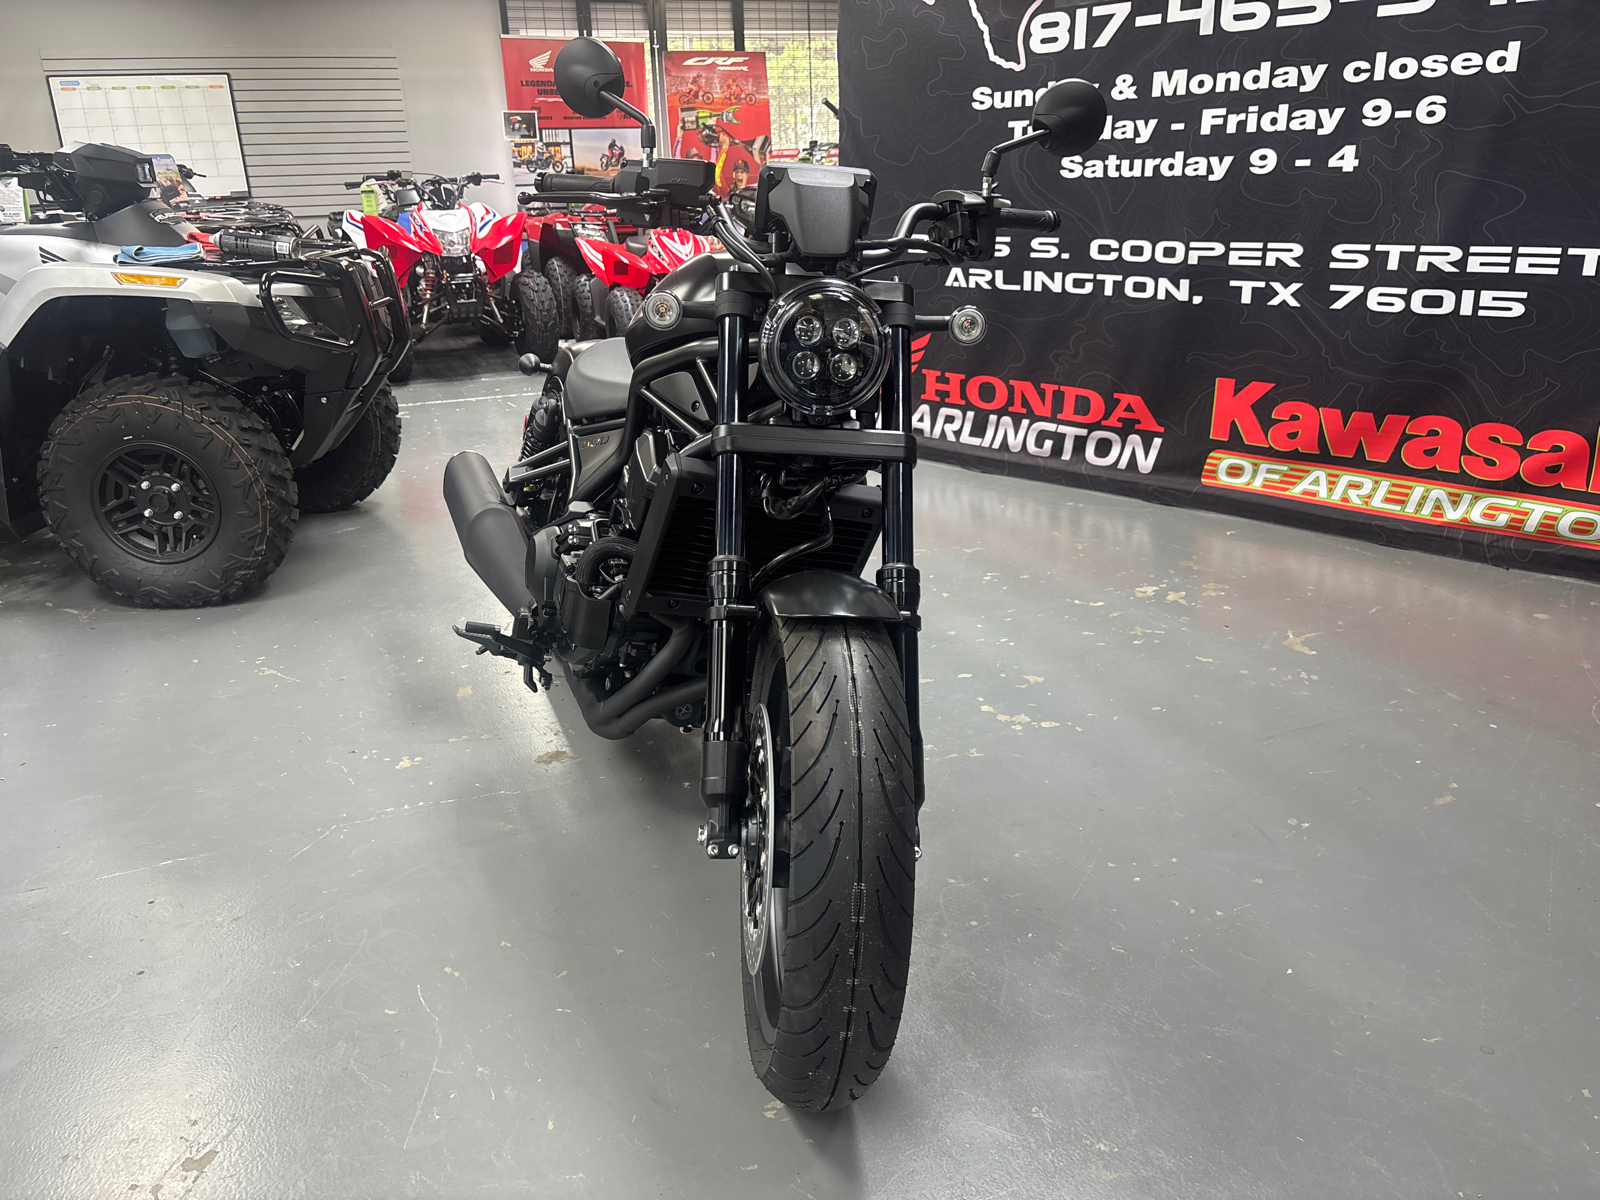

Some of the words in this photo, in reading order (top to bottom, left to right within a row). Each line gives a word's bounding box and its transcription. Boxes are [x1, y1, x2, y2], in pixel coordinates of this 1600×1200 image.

[682, 57, 749, 66] CRF
[1110, 74, 1138, 101] &
[1151, 62, 1329, 98] Monday
[1342, 40, 1521, 83] closed
[1200, 104, 1346, 136] Friday
[1361, 95, 1448, 127] 9-6
[1059, 151, 1234, 182] Saturday
[1248, 148, 1278, 175] 9
[1327, 145, 1360, 172] 4
[1030, 237, 1070, 260] S.
[1089, 239, 1303, 268] COOPER
[1328, 243, 1600, 277] STREET
[944, 267, 1204, 306] ARLINGTON,
[1229, 280, 1304, 308] TX
[1328, 284, 1529, 319] 76015
[920, 369, 1165, 433] HONDA
[911, 404, 1164, 475] ARLINGTON
[1209, 377, 1600, 493] Kawasa
[1216, 457, 1289, 489] OF
